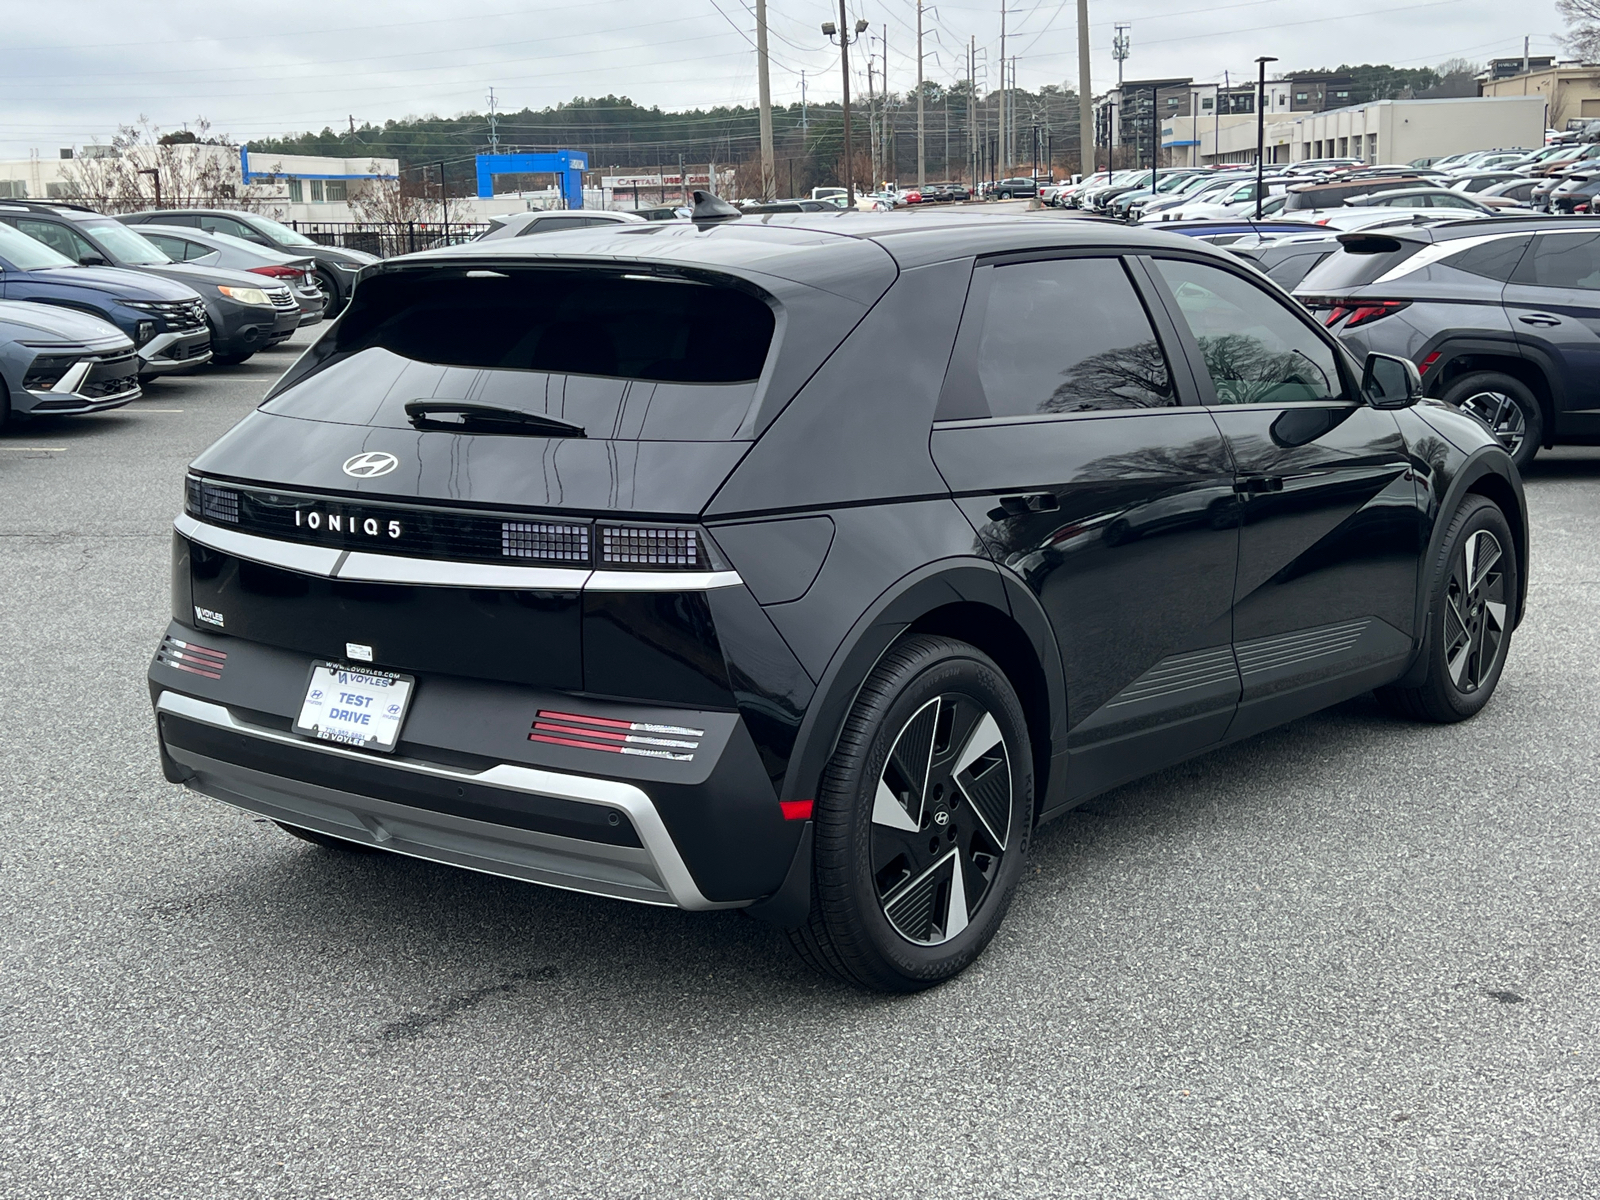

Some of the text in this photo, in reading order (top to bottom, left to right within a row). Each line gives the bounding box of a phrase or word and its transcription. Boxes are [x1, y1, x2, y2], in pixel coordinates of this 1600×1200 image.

[350, 673, 389, 687] VOYLES
[339, 692, 374, 708] TEST
[329, 708, 371, 725] DRIVE
[317, 731, 365, 746] ED VOYLES
[1019, 772, 1032, 855] KUMHO
